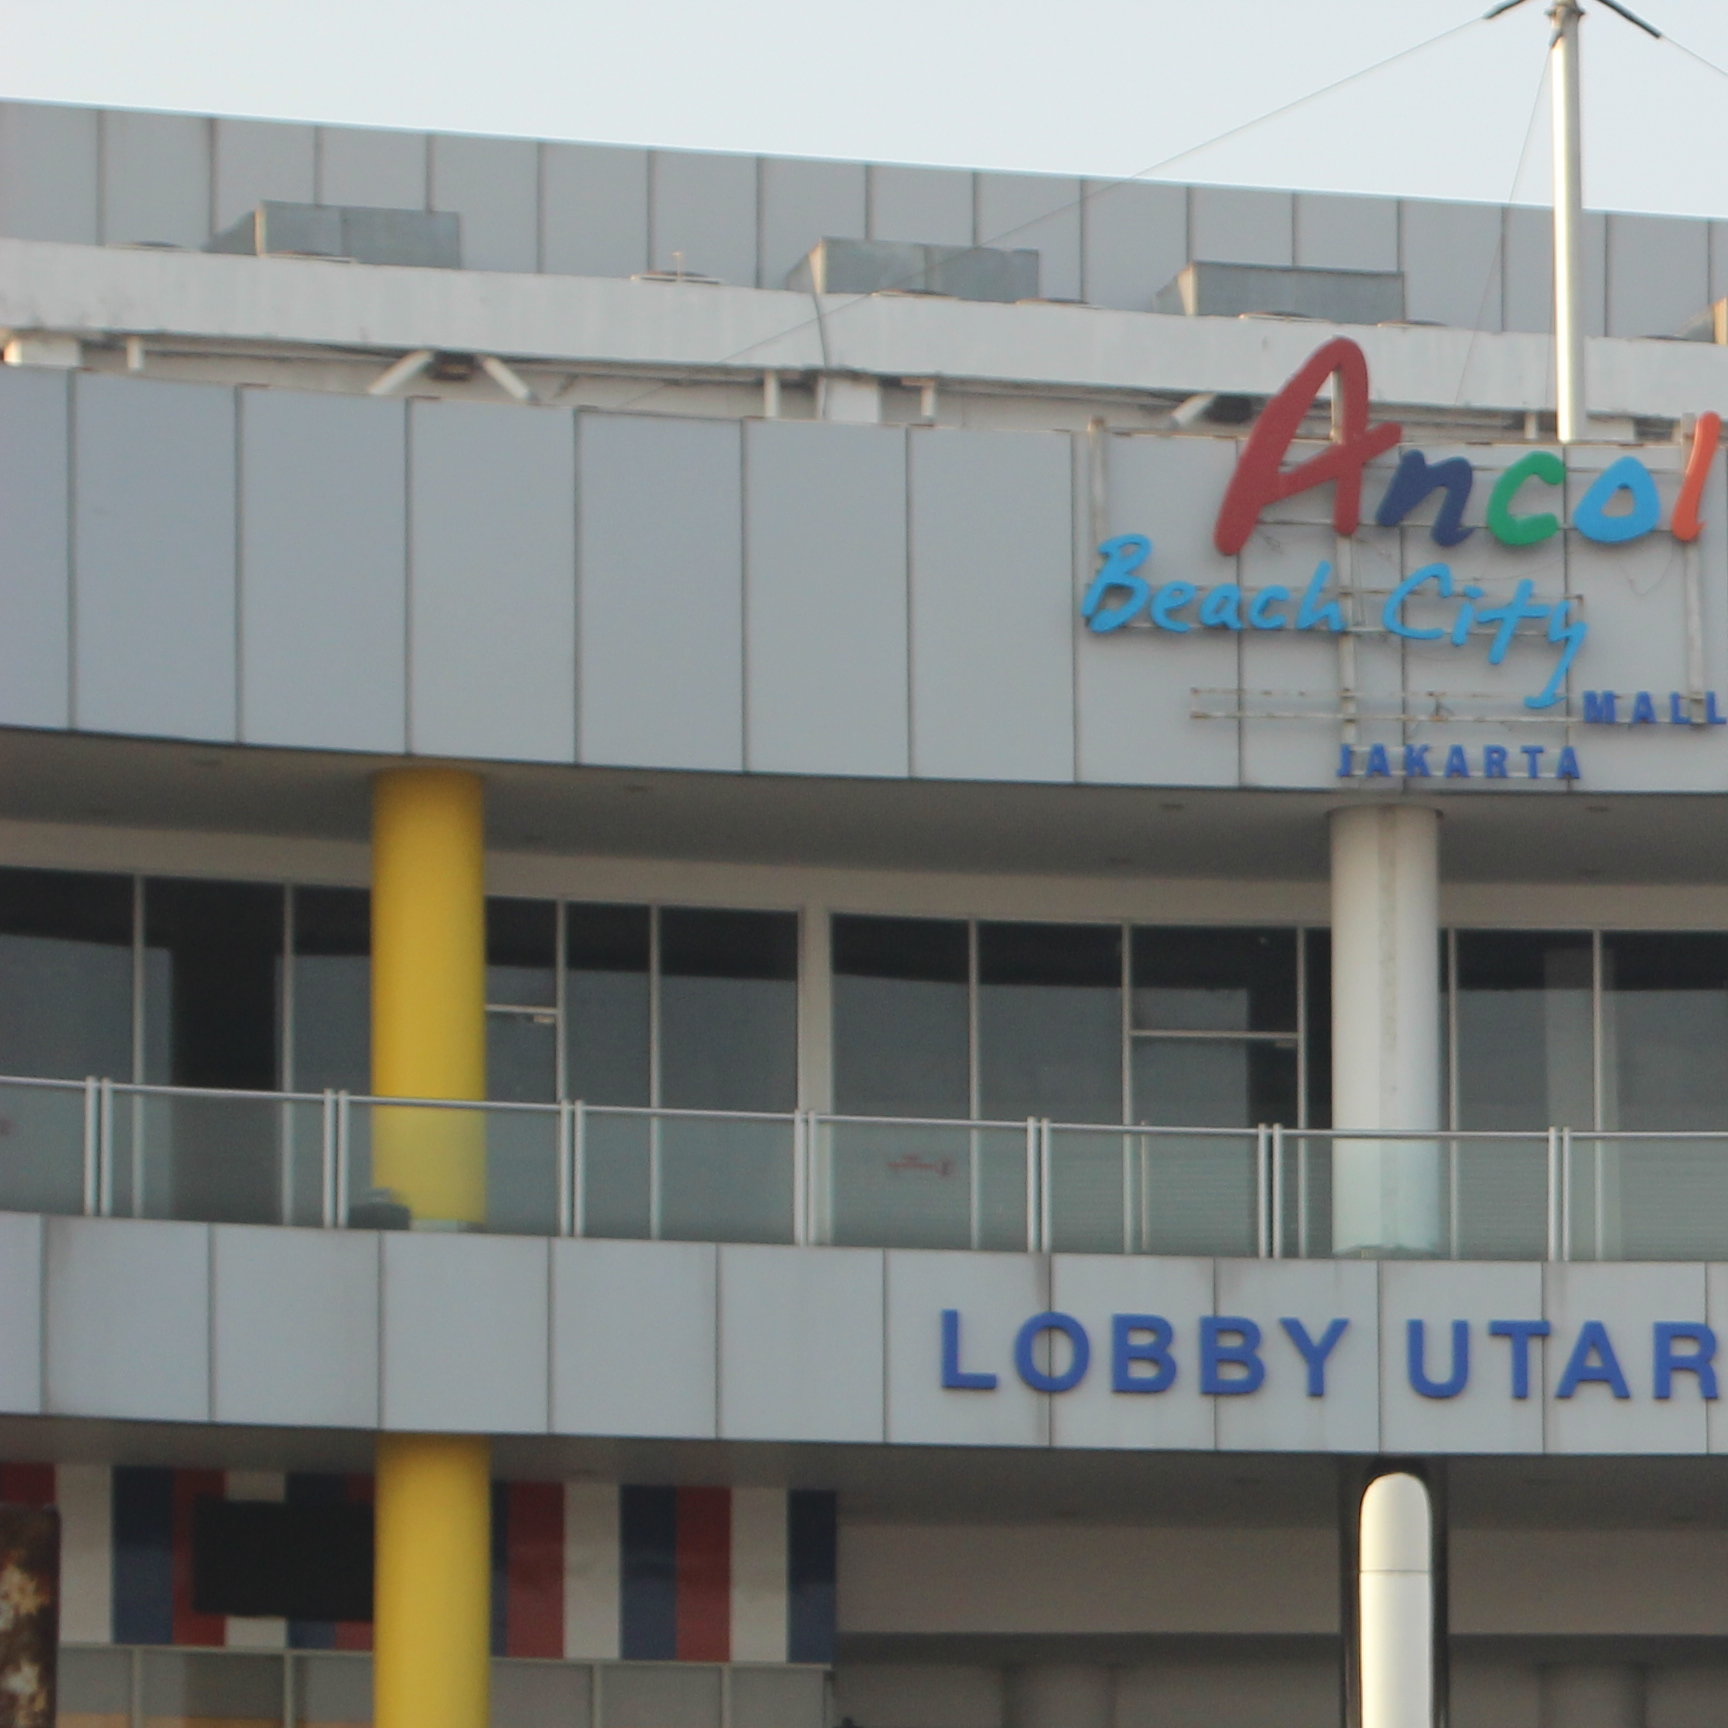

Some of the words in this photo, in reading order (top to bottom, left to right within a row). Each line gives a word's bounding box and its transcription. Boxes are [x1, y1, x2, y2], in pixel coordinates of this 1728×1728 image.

[1214, 336, 1722, 555] Ancol
[1081, 533, 1346, 633] Beach
[1381, 562, 1589, 709] City
[1582, 690, 1728, 726] MALL
[1337, 744, 1582, 780] JAKARTA
[940, 1308, 1350, 1397] LOBBY
